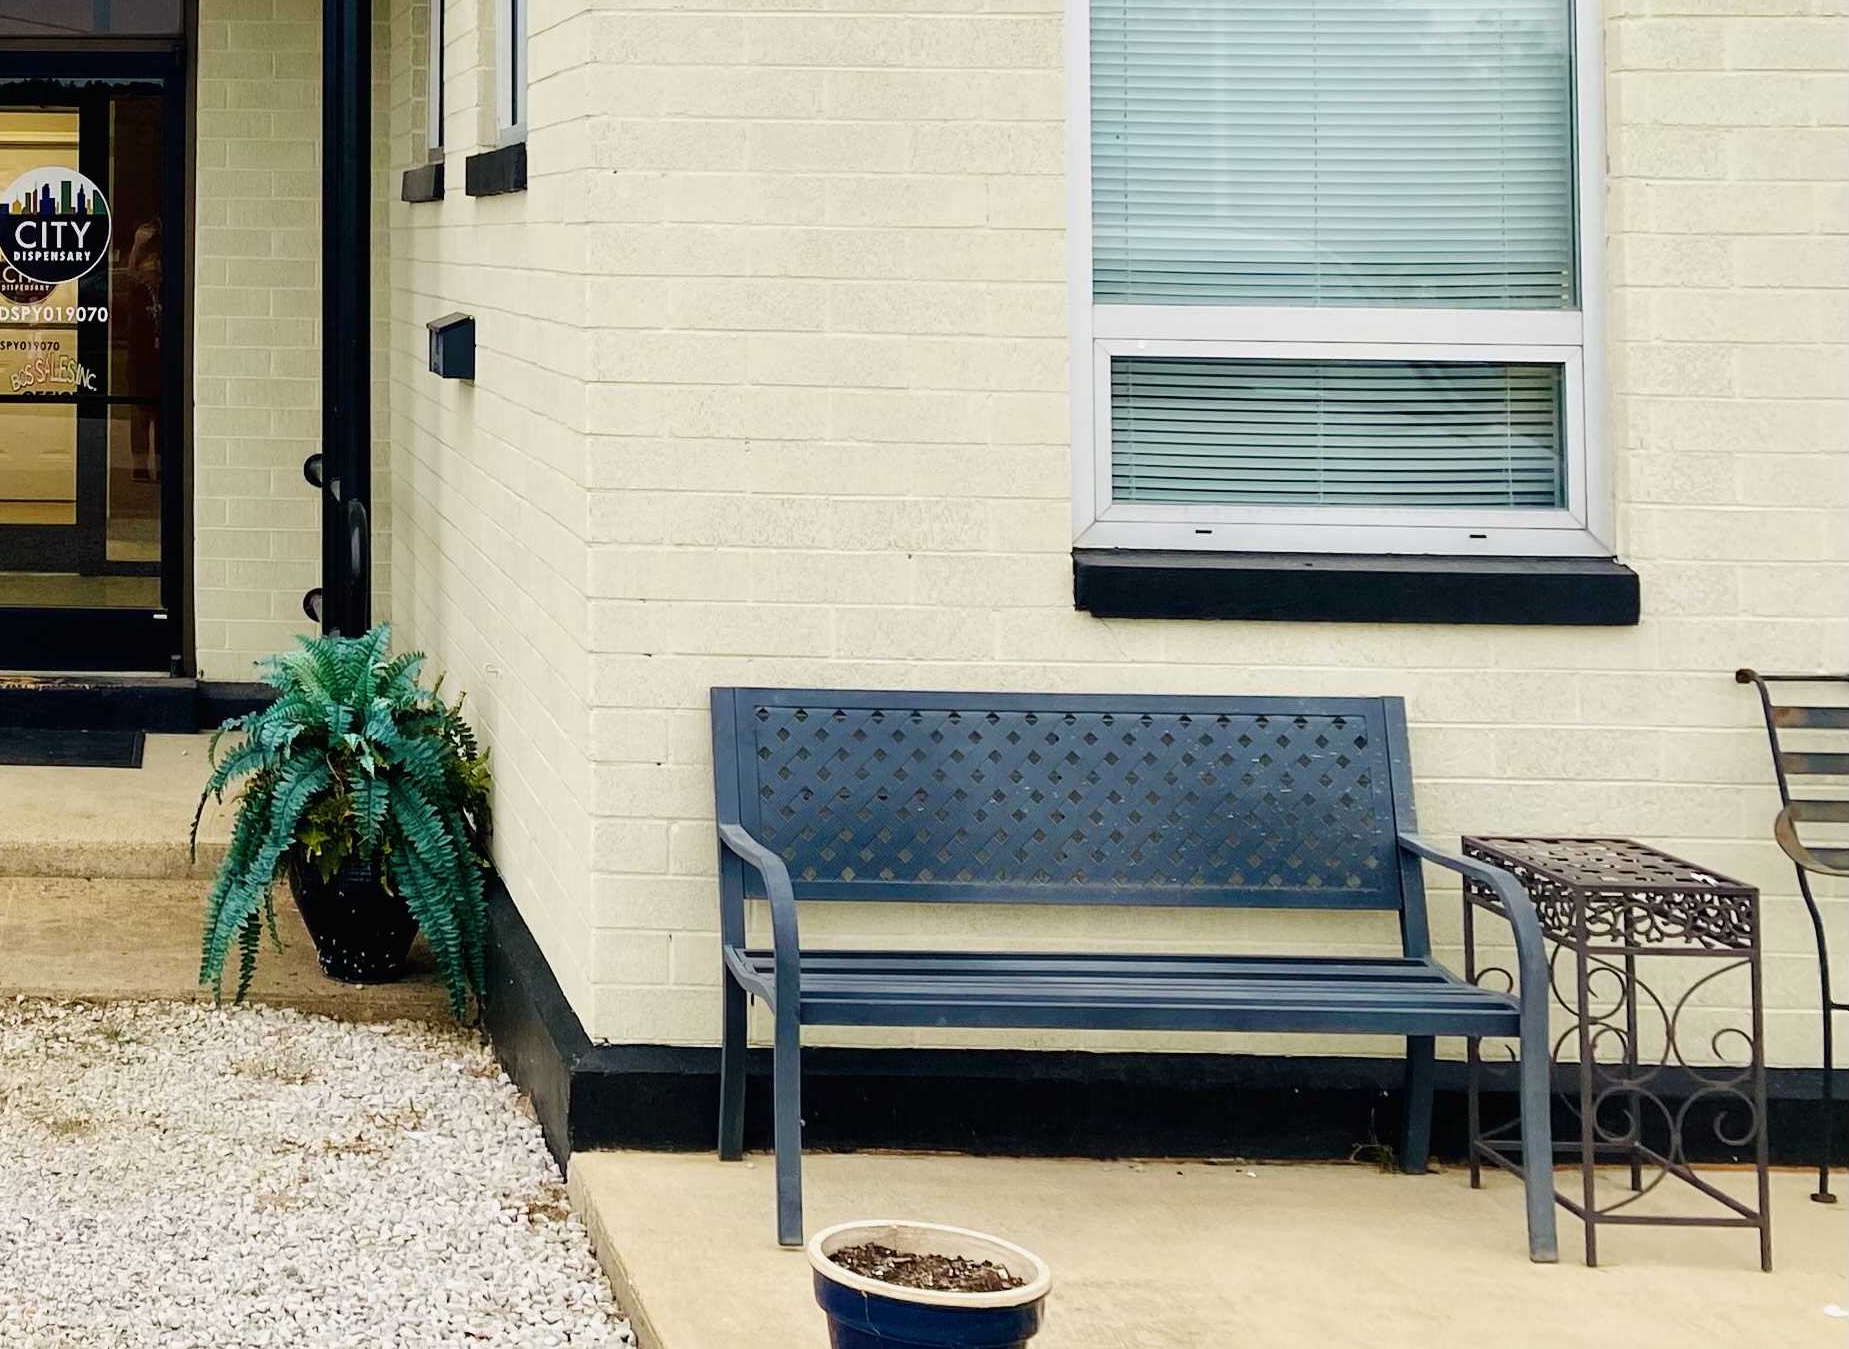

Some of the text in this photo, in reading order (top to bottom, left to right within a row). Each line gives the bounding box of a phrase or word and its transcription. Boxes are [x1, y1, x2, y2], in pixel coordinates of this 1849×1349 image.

[15, 221, 92, 249] CITY
[13, 250, 91, 262] DISPENSARY
[10, 363, 35, 392] BOS
